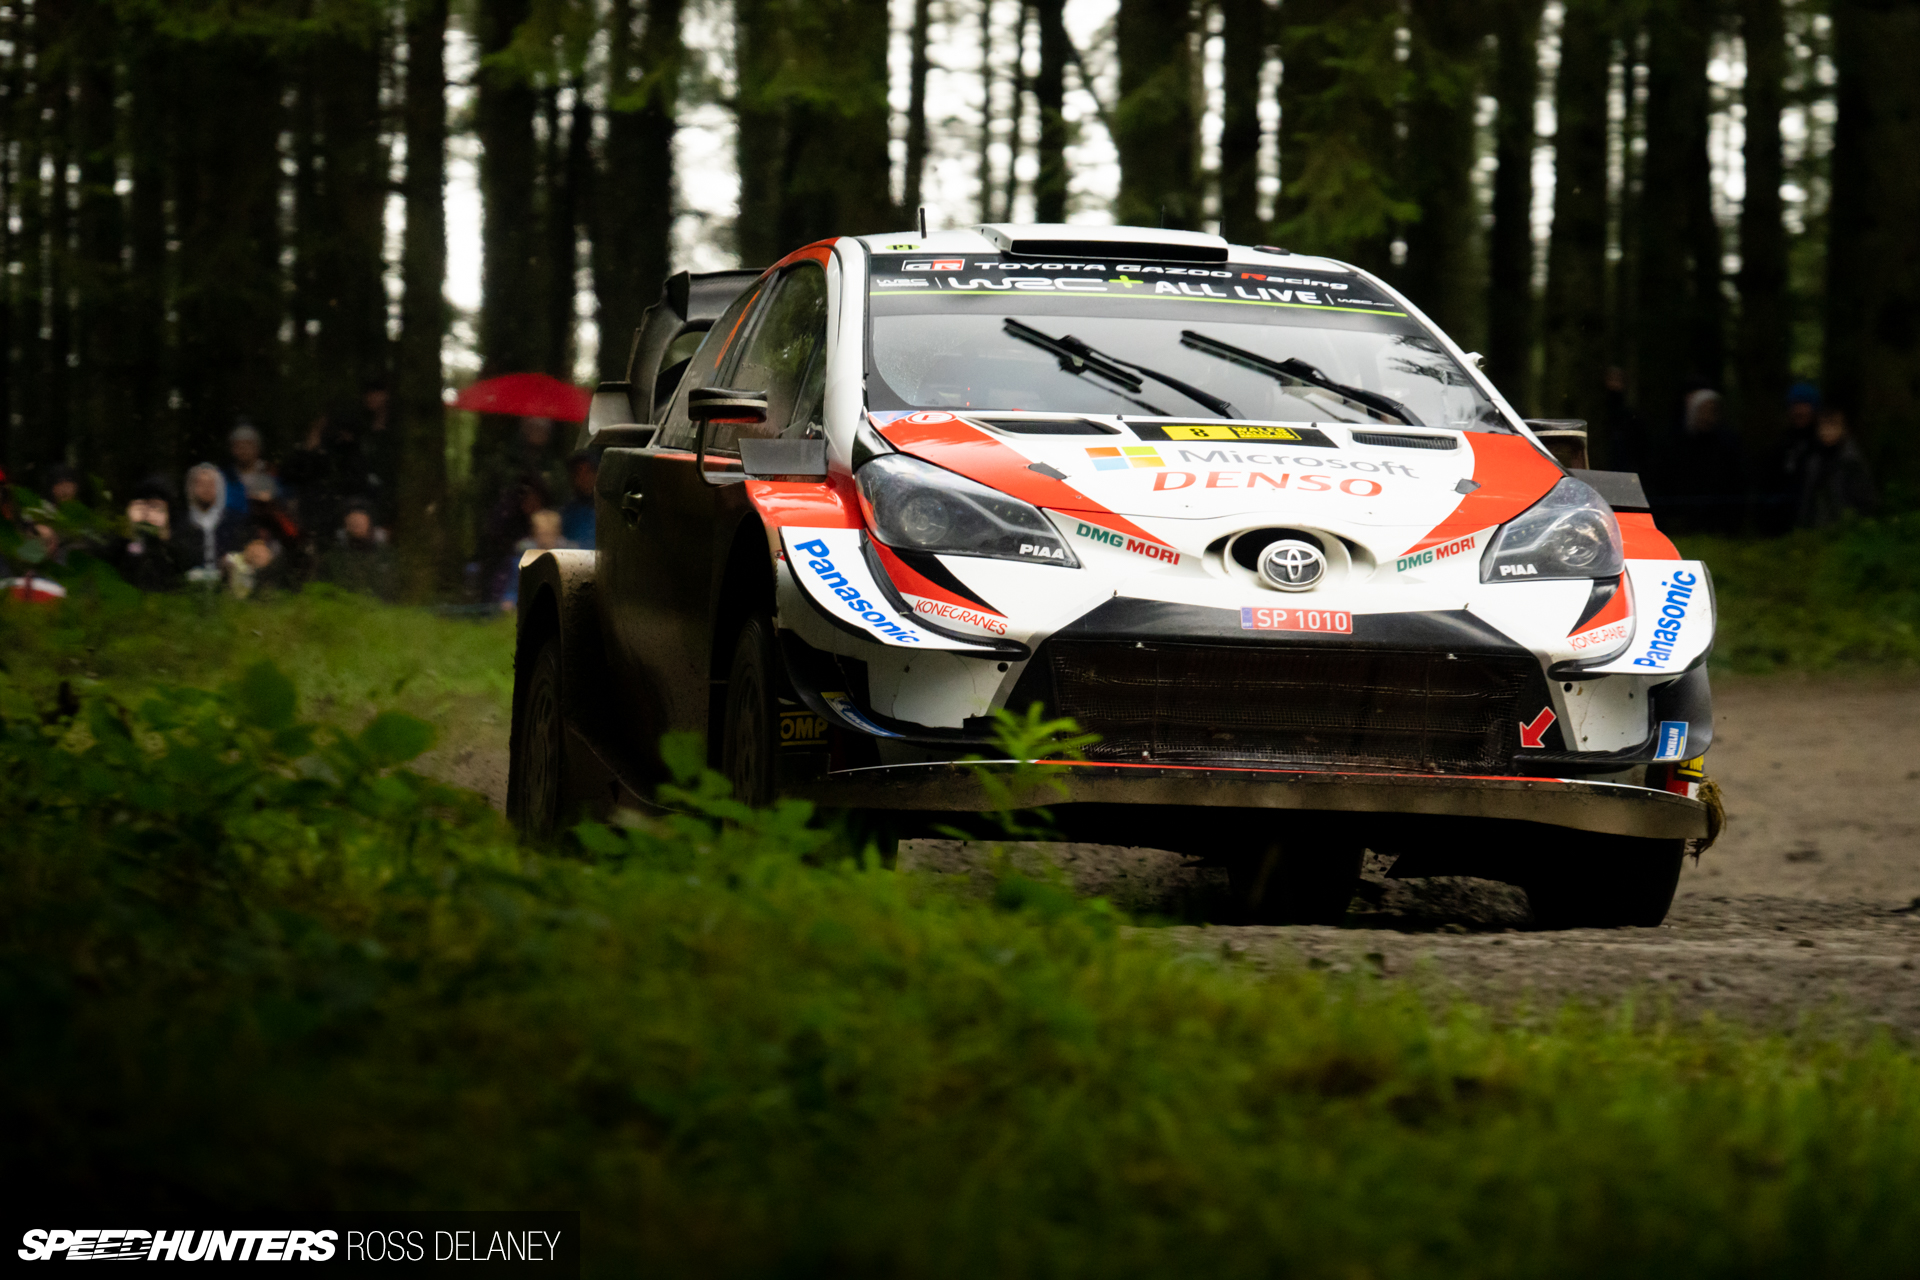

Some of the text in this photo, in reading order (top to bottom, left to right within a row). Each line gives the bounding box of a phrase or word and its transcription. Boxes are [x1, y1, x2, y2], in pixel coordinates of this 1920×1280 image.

[904, 260, 1349, 290] GR TOYOTA GAZOO Racing
[1155, 280, 1228, 297] ALL
[1234, 285, 1323, 305] LIVE
[1189, 428, 1210, 438] 8
[1177, 449, 1420, 479] Microsoft
[1152, 471, 1383, 497] DENSO
[1019, 543, 1065, 560] PIAA
[1076, 523, 1181, 566] DMG MORI
[1396, 536, 1476, 573] DMG MORI
[1499, 563, 1538, 576] PIAA
[793, 538, 920, 643] Panasonic
[914, 599, 1008, 636] KONECRANES
[1257, 609, 1348, 631] SP 1010
[1632, 570, 1697, 669] Panasonic
[1568, 625, 1628, 651] KONECRANES
[780, 717, 829, 740] OMP
